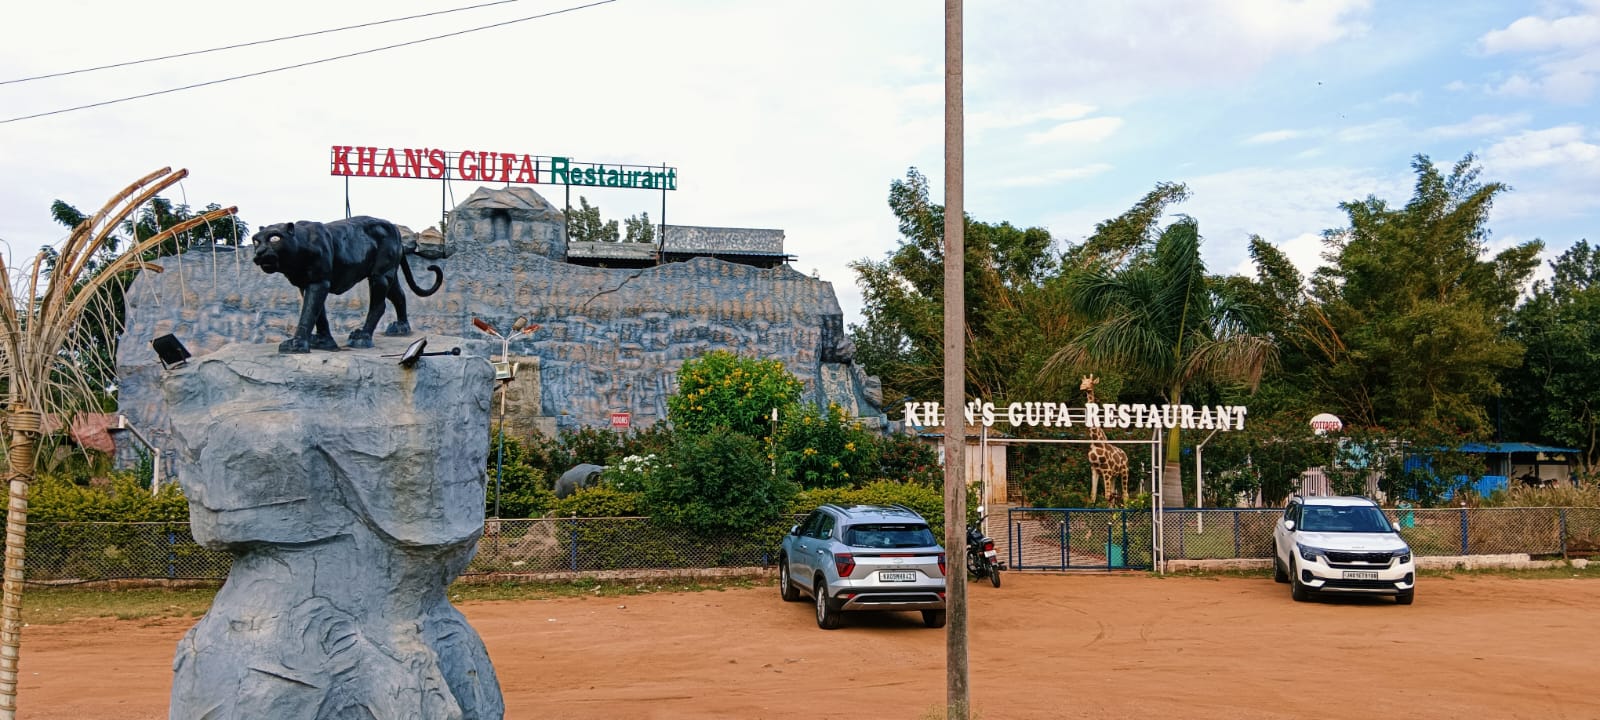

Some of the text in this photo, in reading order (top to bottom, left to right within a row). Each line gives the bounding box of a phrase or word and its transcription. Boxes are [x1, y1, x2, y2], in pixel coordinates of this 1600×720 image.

[332, 146, 676, 190] KHAN'S GUFA Restaurant
[904, 397, 1247, 431] KHN'S GUFA RESTAURANT
